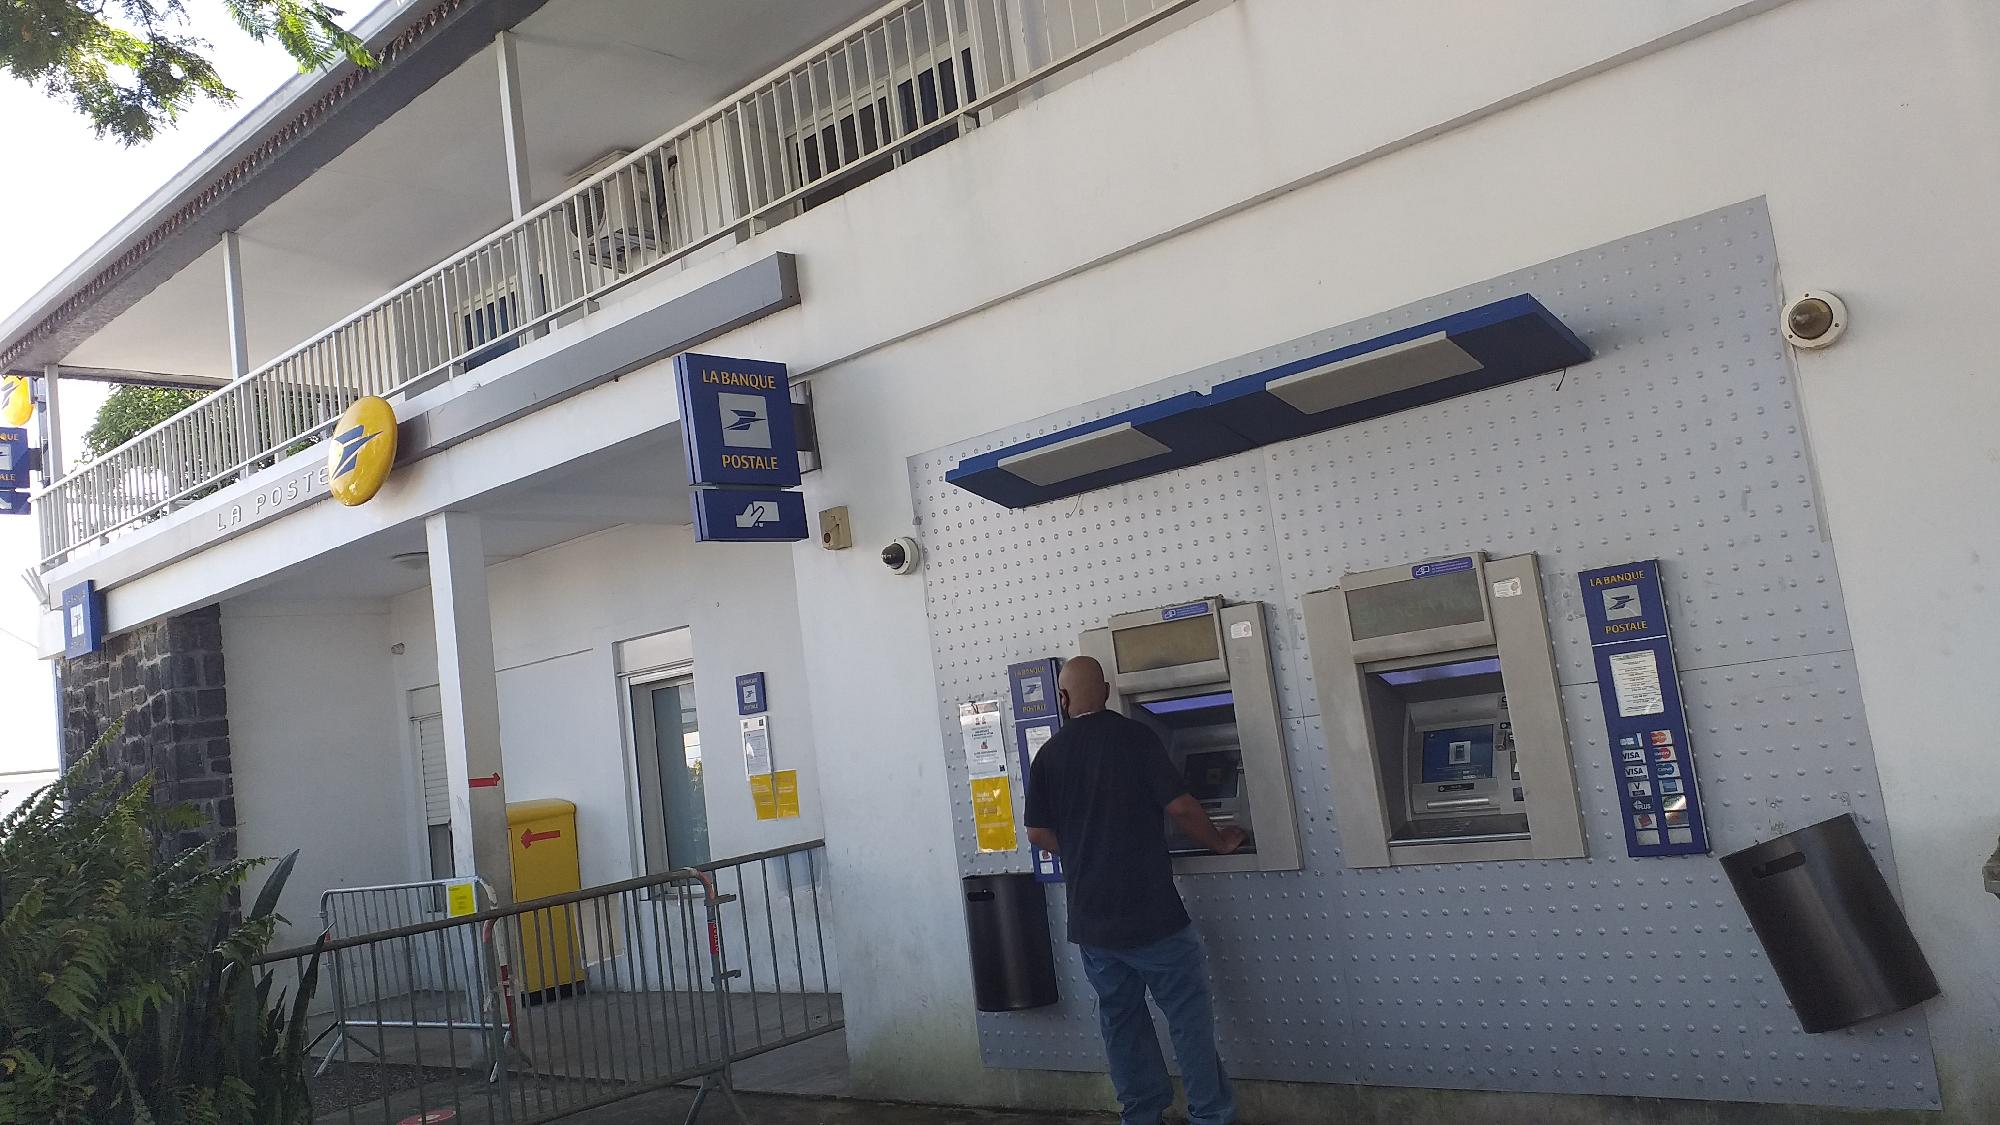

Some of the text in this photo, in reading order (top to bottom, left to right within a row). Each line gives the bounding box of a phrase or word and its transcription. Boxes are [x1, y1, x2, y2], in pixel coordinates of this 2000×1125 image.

[702, 369, 777, 390] LA BANQUE
[722, 454, 779, 470] POSTALE
[217, 465, 329, 531] LA POSTE
[1590, 570, 1646, 587] LA BANQUE
[1605, 620, 1648, 635] POSTALE
[1622, 751, 1640, 760] VISA
[1625, 767, 1644, 776] VISA
